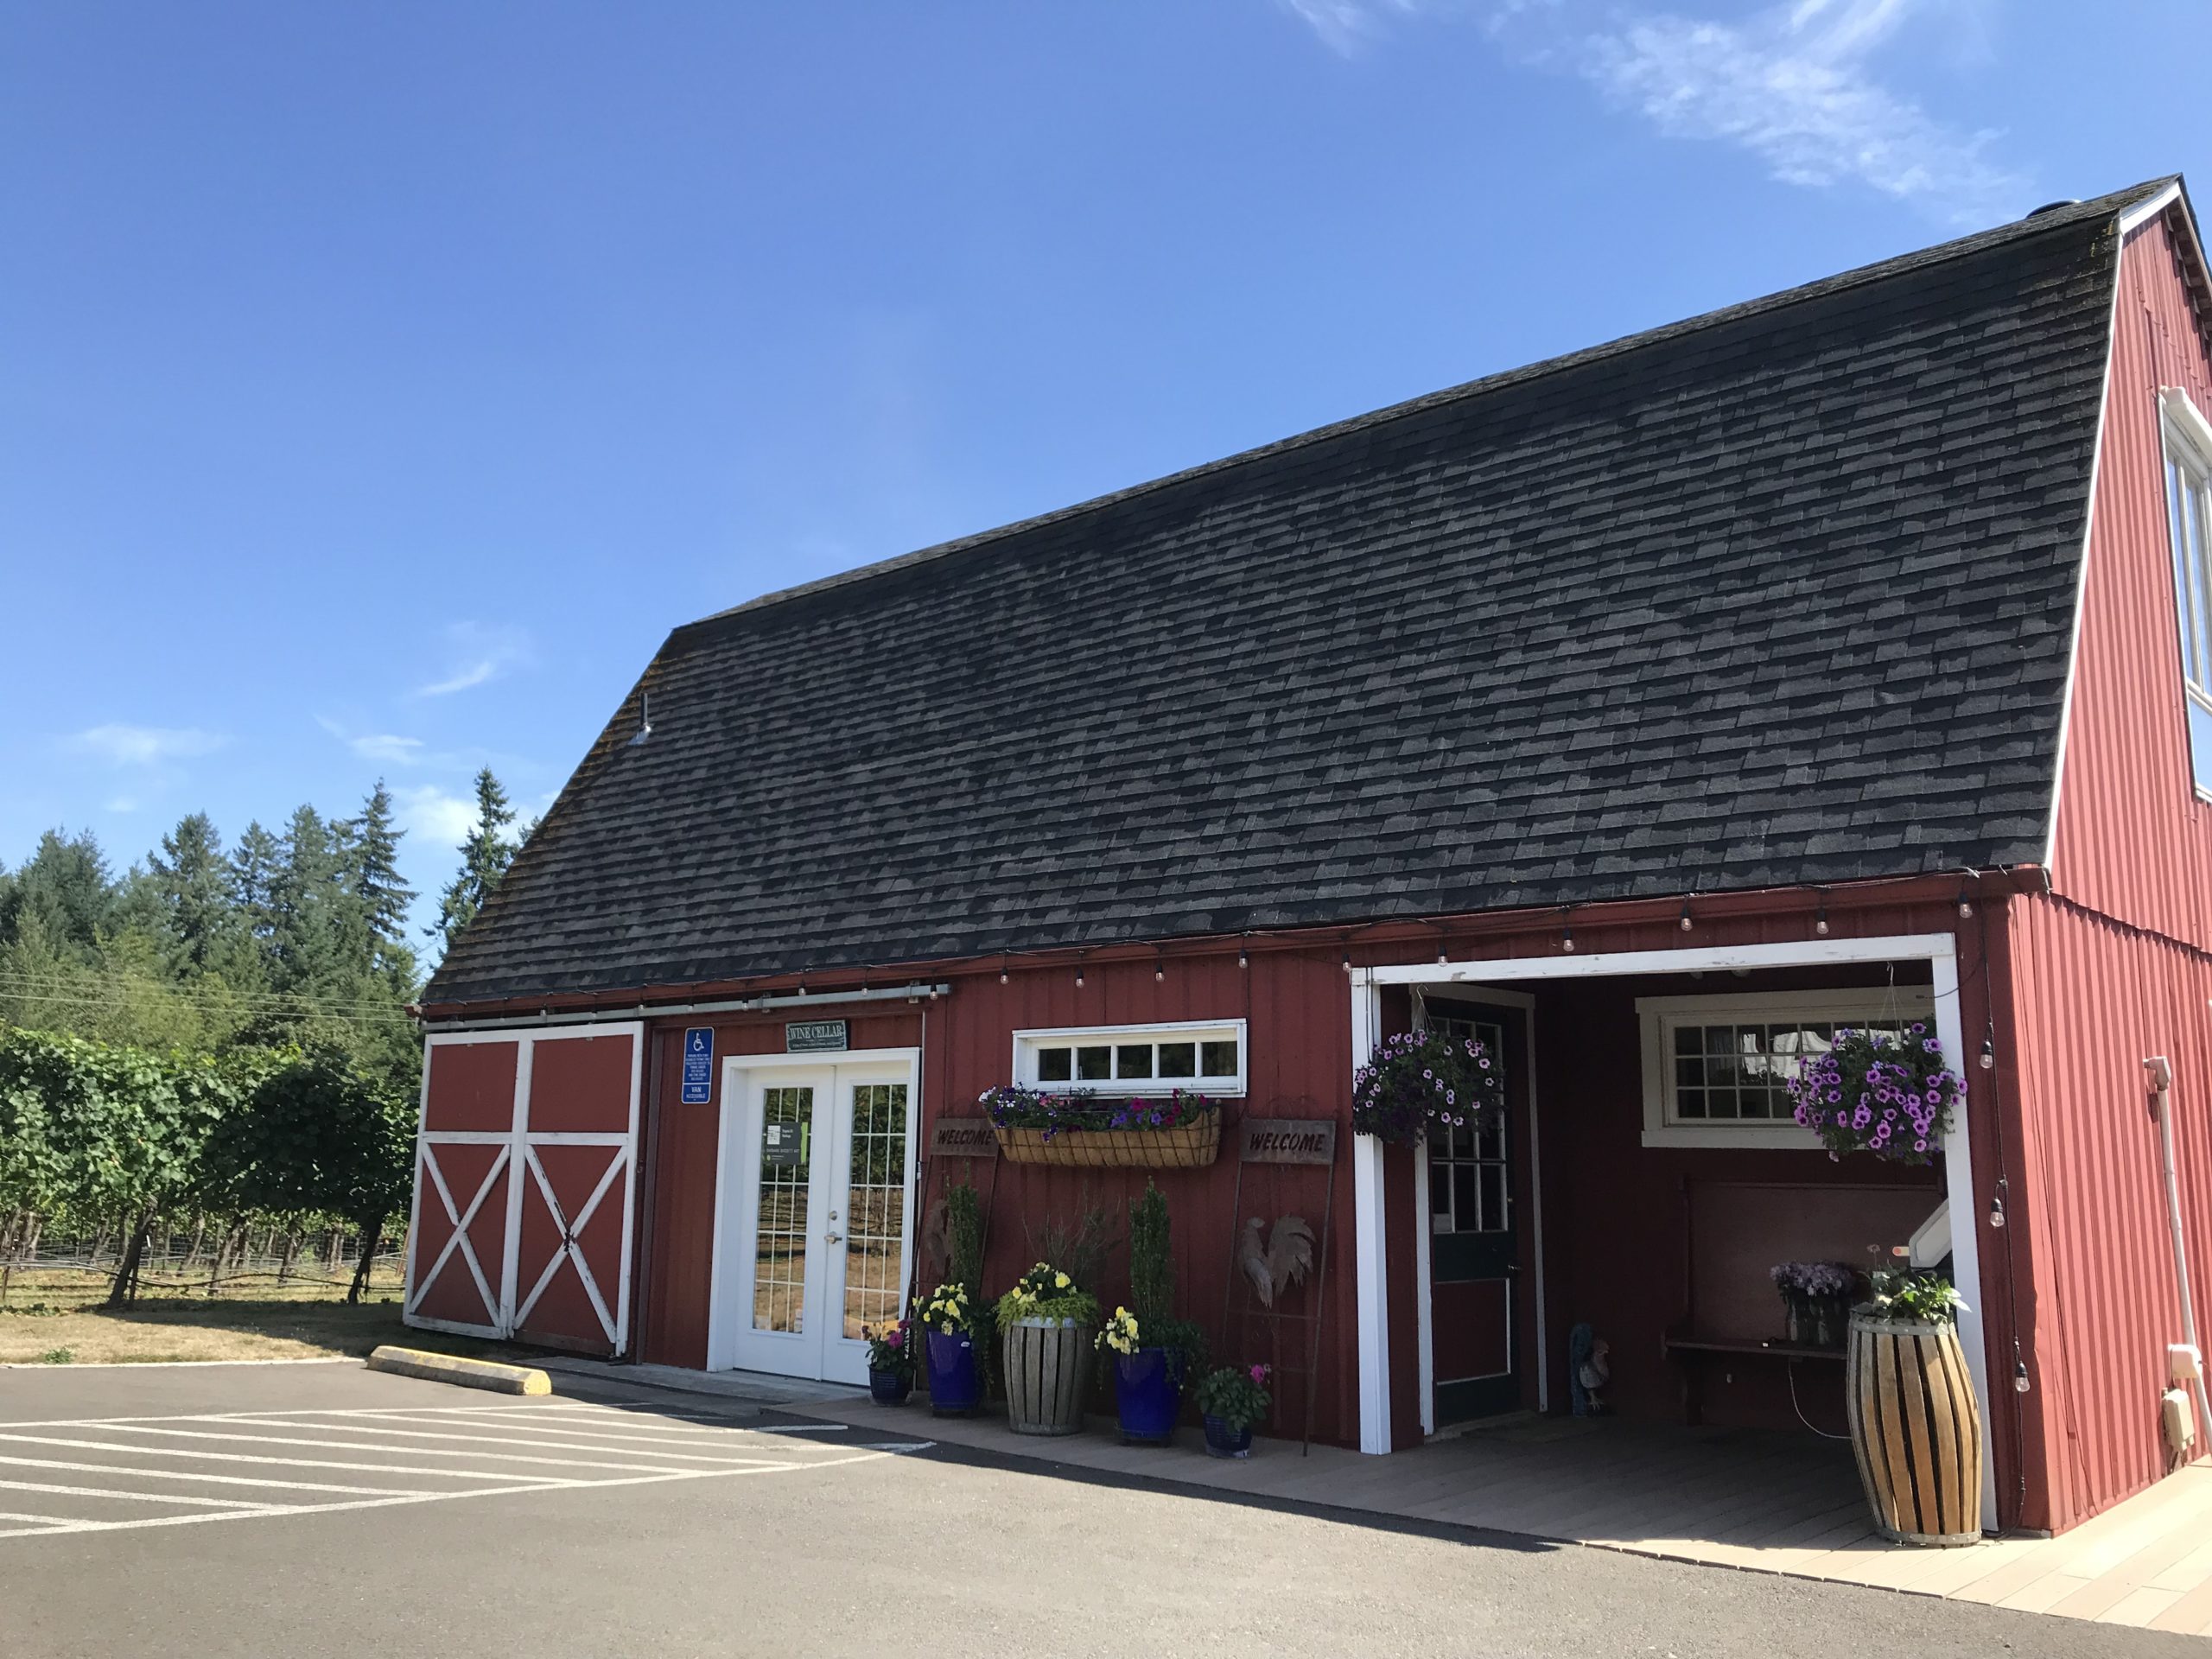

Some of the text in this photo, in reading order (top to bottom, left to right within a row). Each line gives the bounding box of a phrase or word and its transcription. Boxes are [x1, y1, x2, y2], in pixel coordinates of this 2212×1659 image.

[789, 1025, 842, 1039] WINE CELLAR
[938, 1129, 995, 1145] WELCOME
[1249, 1133, 1325, 1152] WELCOME
